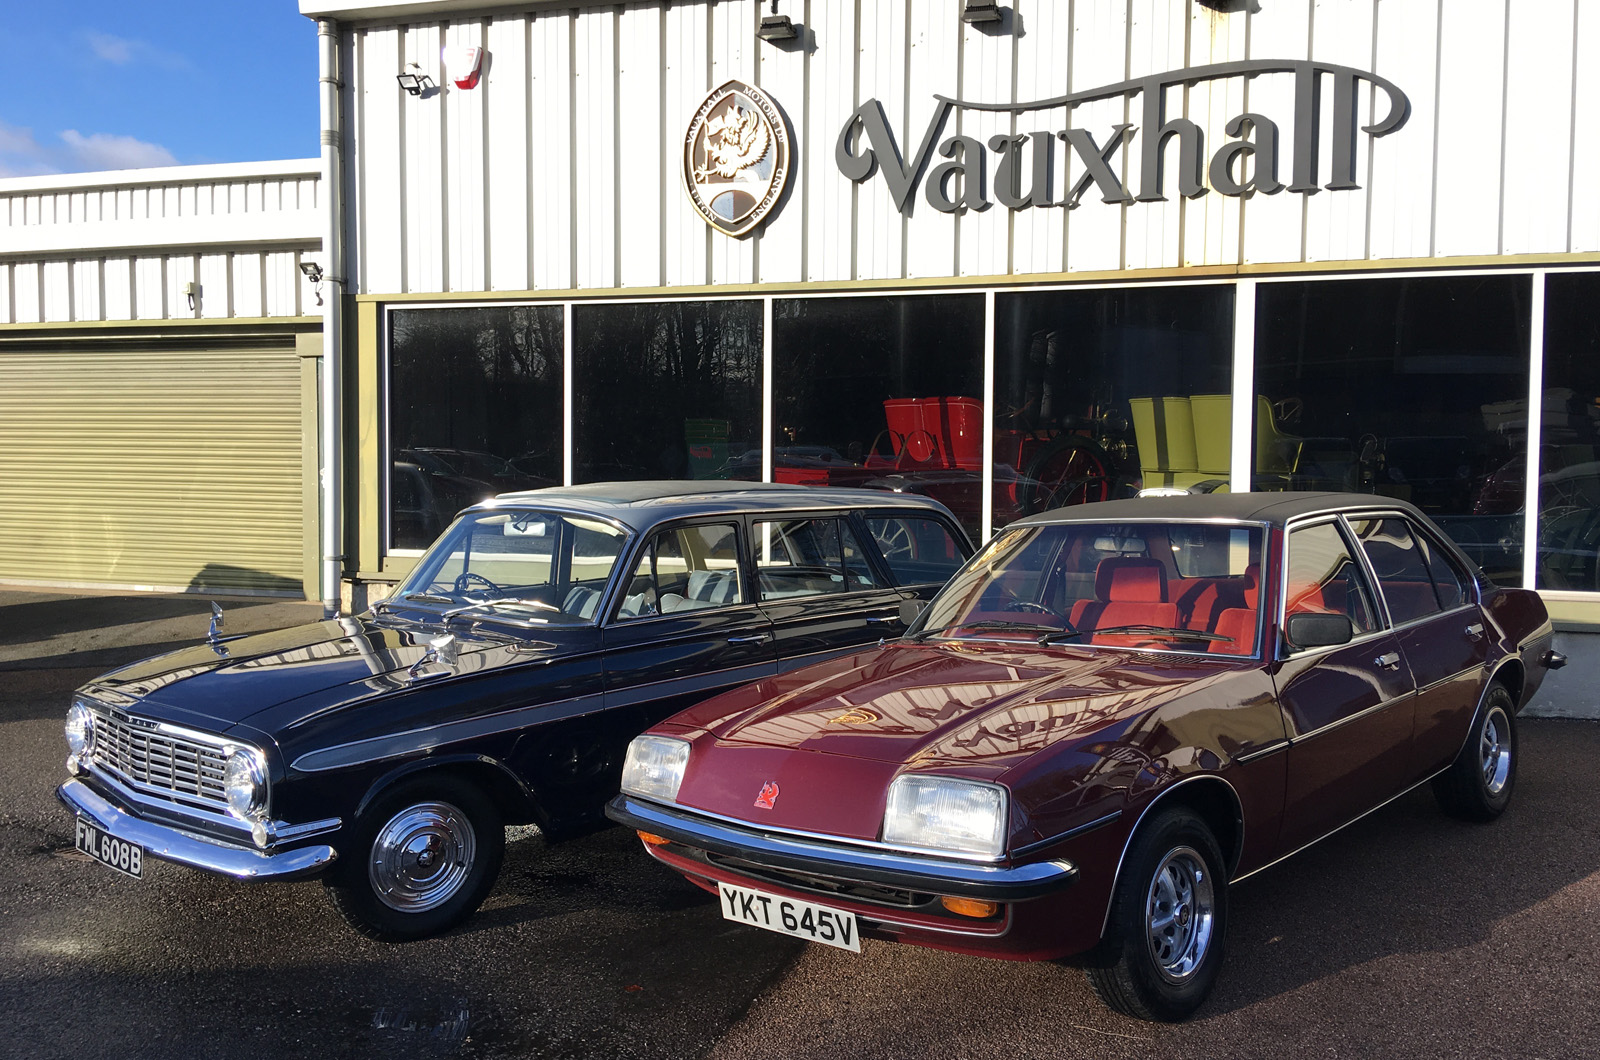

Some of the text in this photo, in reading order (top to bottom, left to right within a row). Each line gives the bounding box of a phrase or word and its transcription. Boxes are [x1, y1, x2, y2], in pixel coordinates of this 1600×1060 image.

[687, 88, 726, 143] VAUXHALL
[743, 86, 777, 125] MOTORS
[835, 59, 1410, 214] Vauxhall
[751, 168, 783, 221] ENGLAND
[722, 888, 851, 946] YKT 645V
